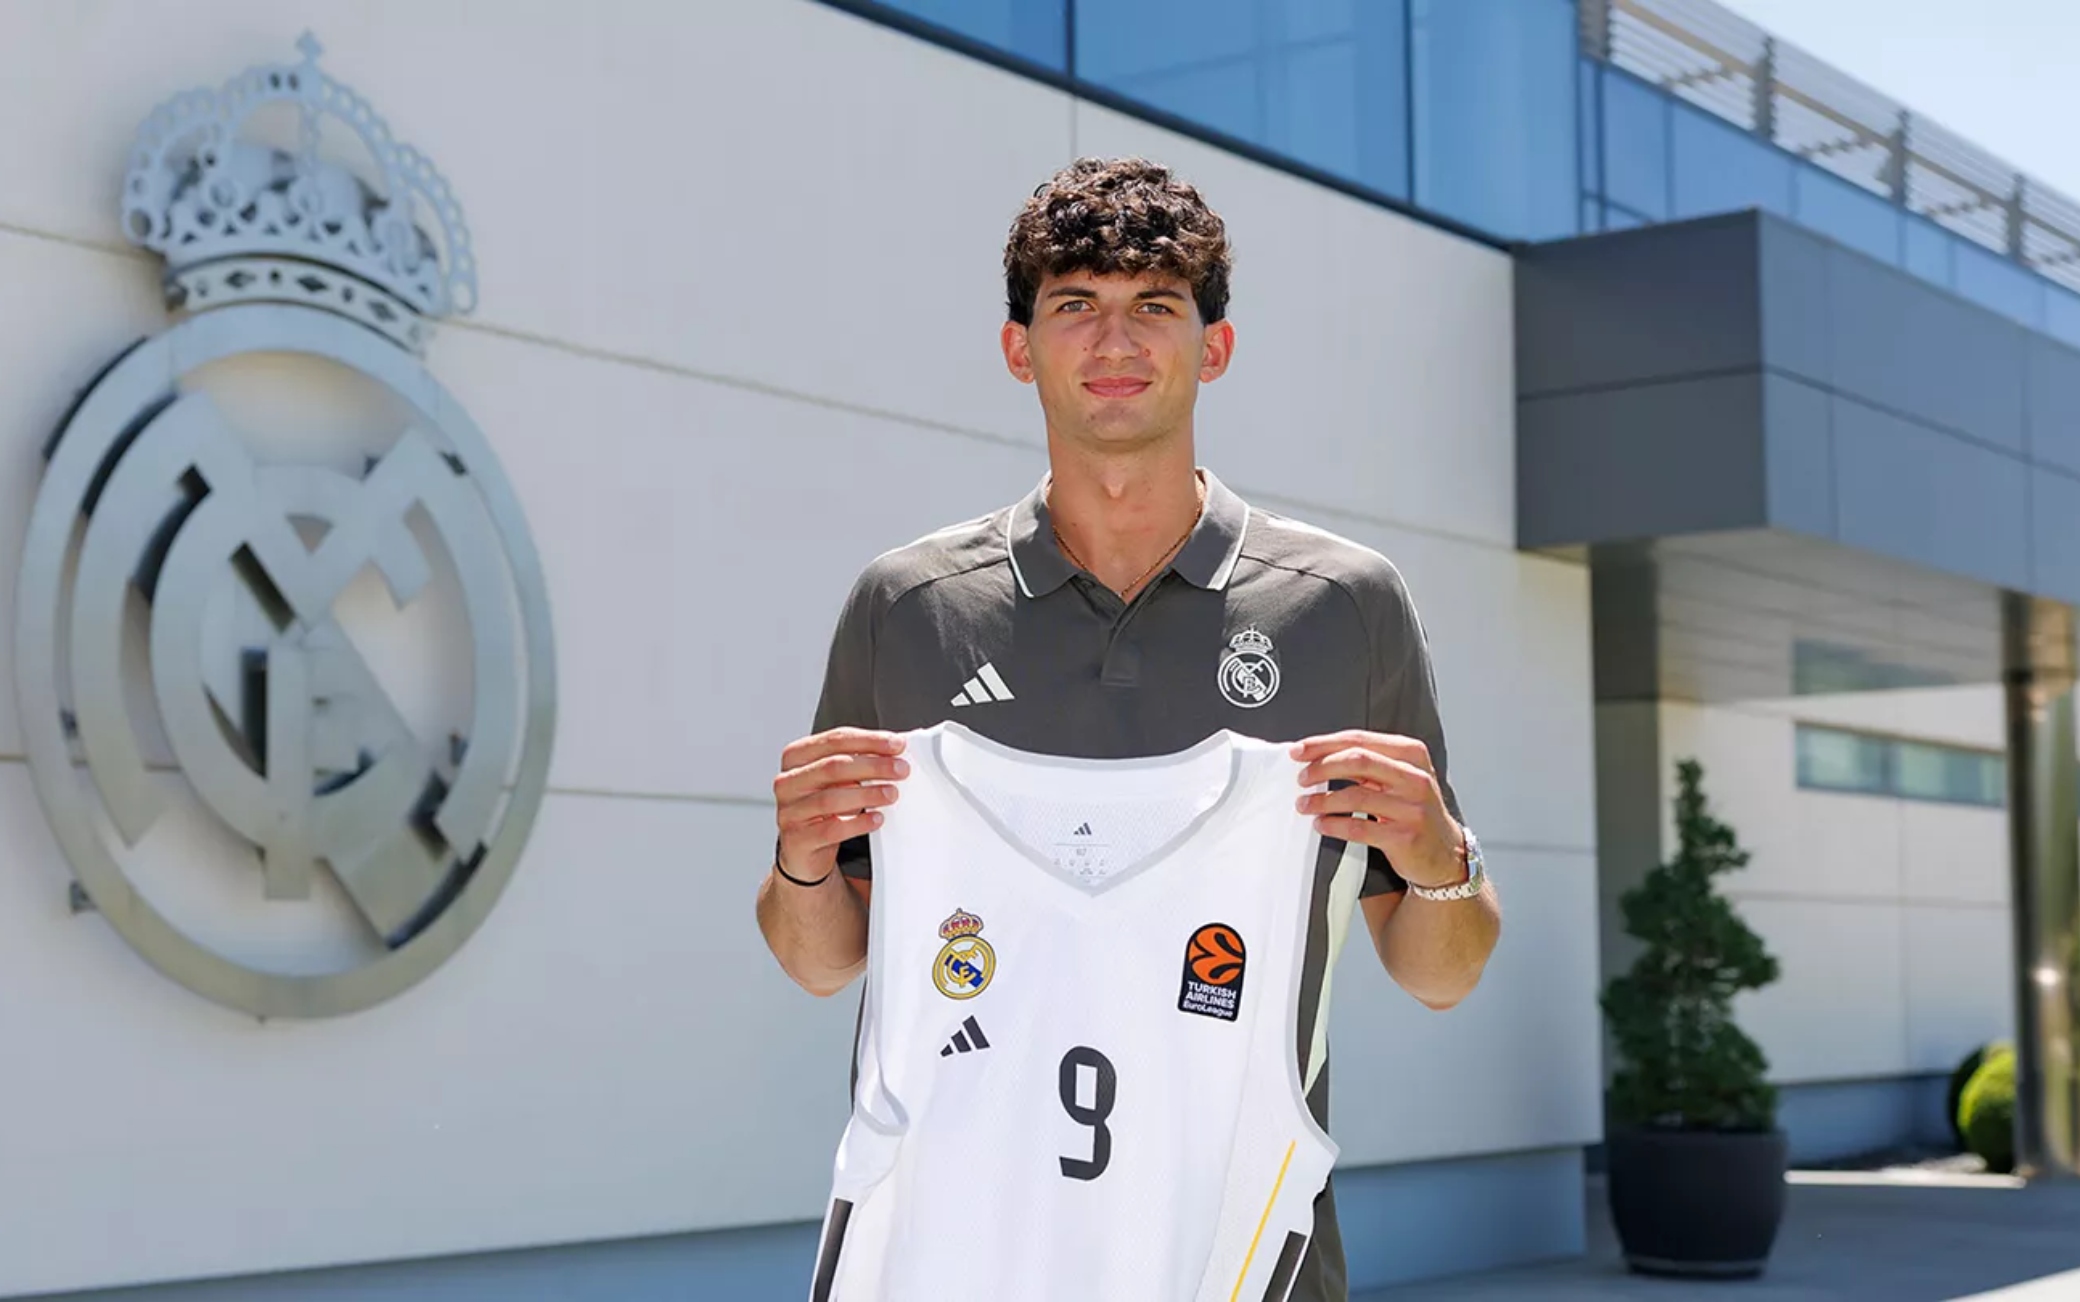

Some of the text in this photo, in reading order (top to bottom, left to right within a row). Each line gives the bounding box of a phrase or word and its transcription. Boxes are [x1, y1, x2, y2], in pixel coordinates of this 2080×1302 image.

[1187, 981, 1237, 999] TURKISH
[1183, 1000, 1233, 1018] EuroLeague
[1185, 991, 1235, 1009] AIRLINES
[1058, 1046, 1117, 1181] 9
